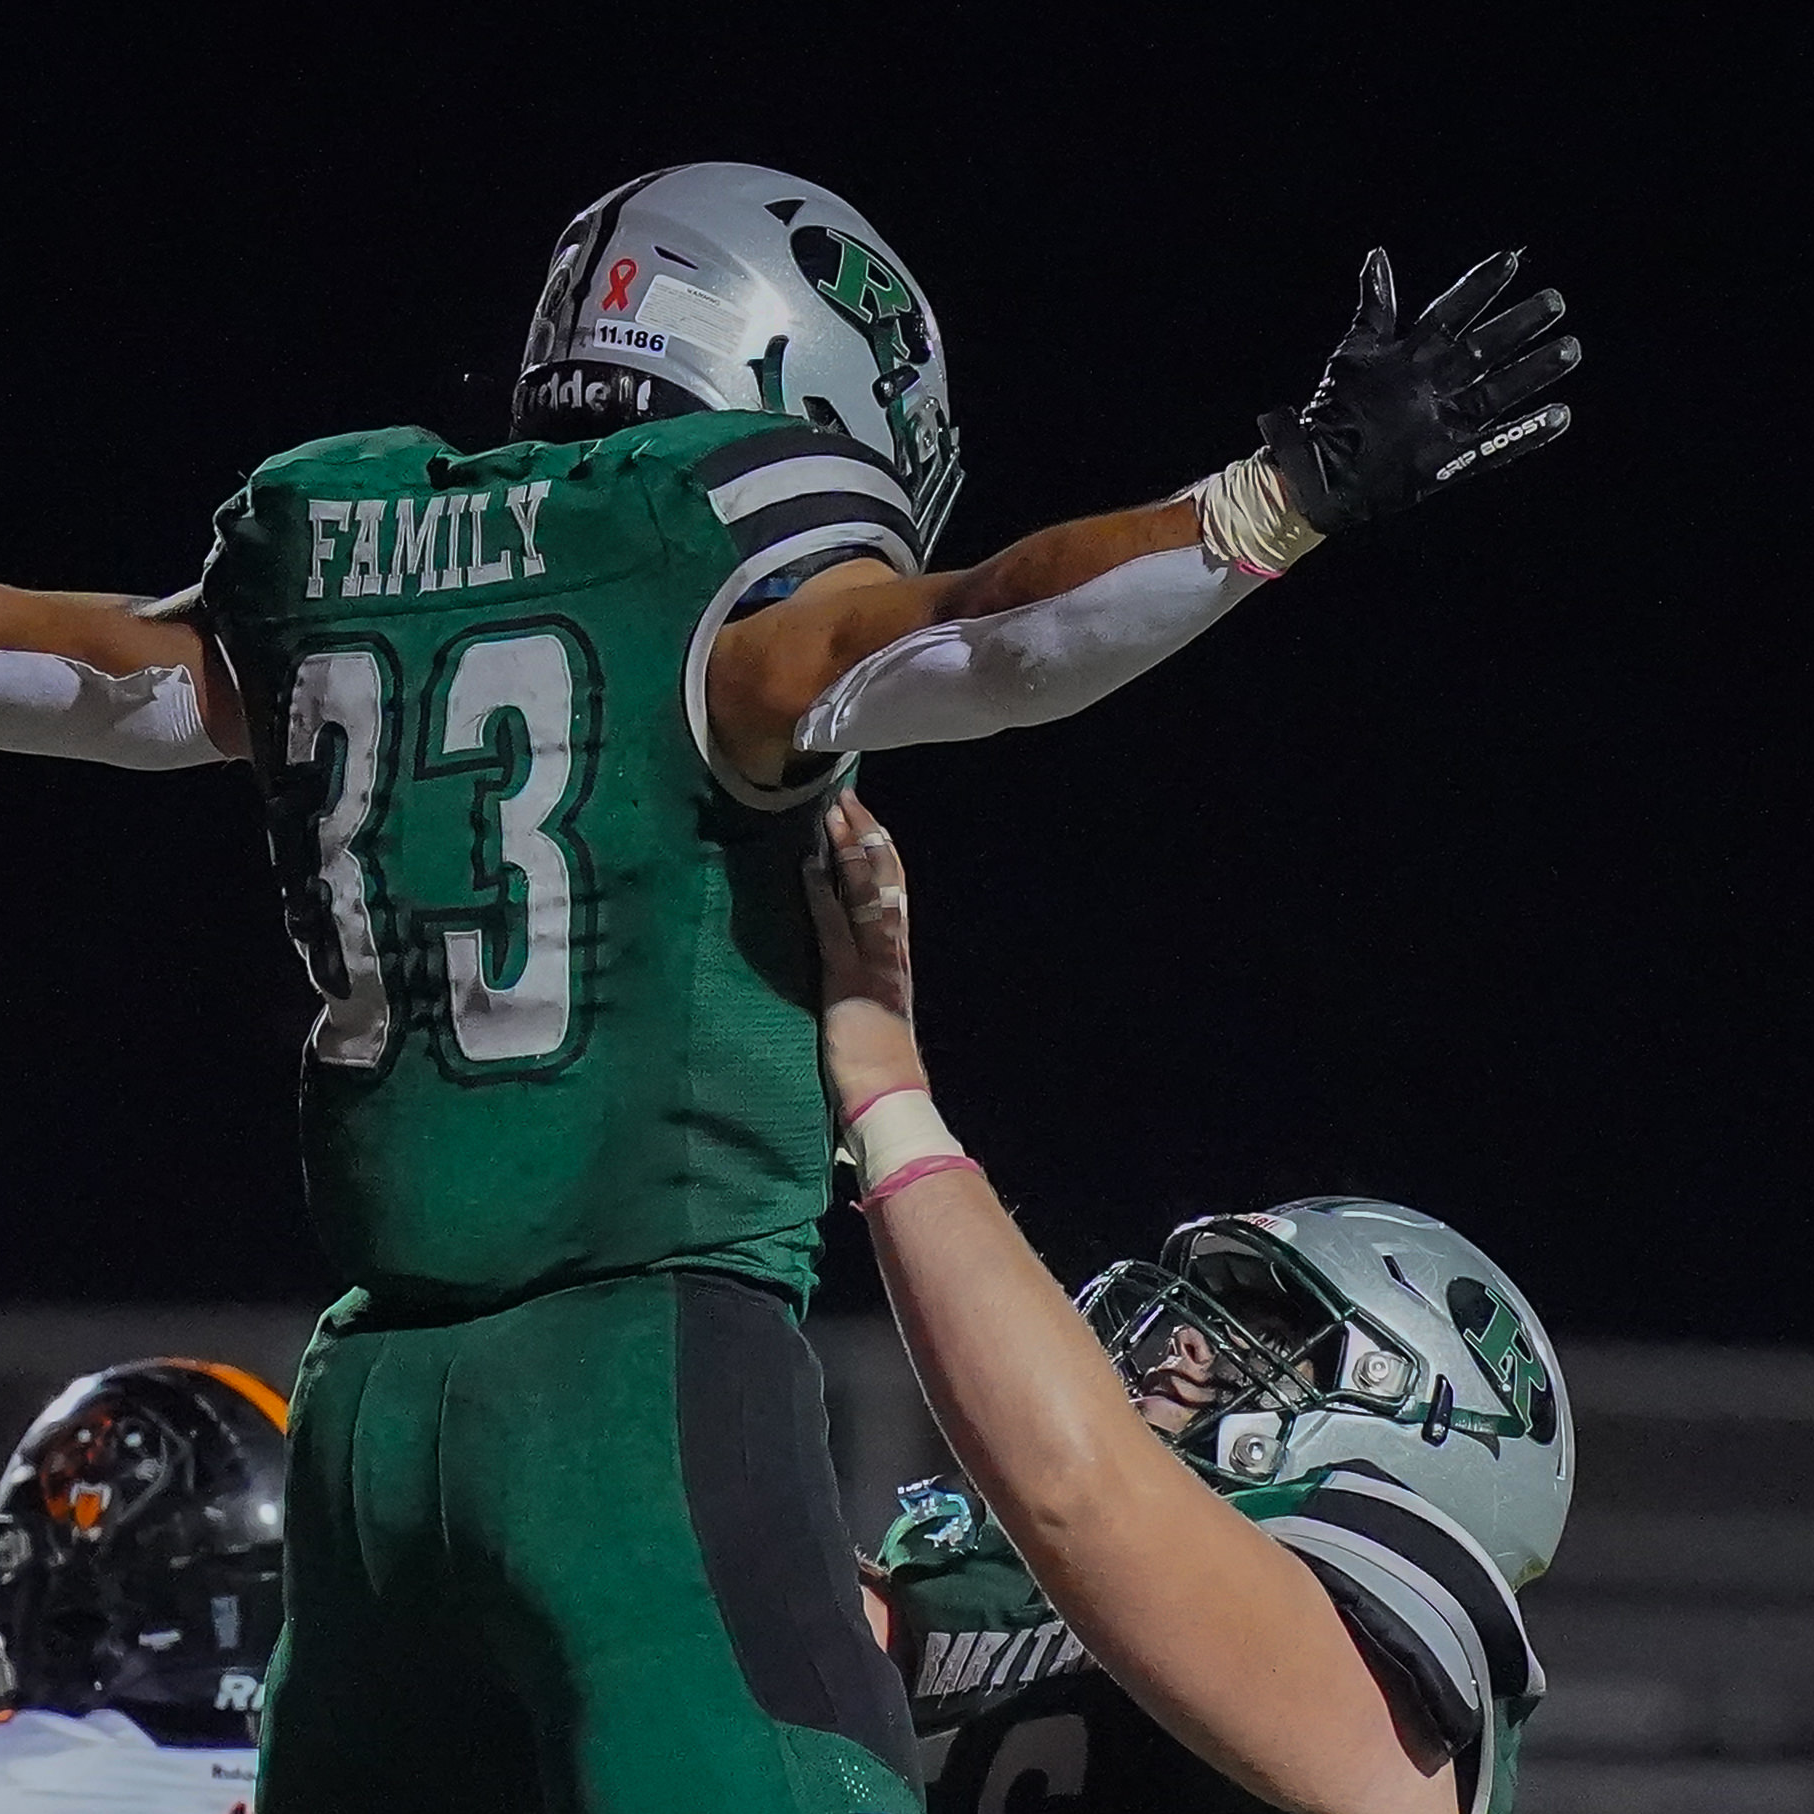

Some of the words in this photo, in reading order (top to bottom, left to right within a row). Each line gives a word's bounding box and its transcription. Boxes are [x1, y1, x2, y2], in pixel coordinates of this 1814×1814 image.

[599, 324, 665, 353] 11.186
[817, 228, 924, 359] R
[1436, 450, 1477, 480] GRIP
[1480, 412, 1548, 456] BOOST
[305, 479, 552, 598] FAMILY
[287, 633, 573, 1069] 33
[1462, 1286, 1547, 1433] R
